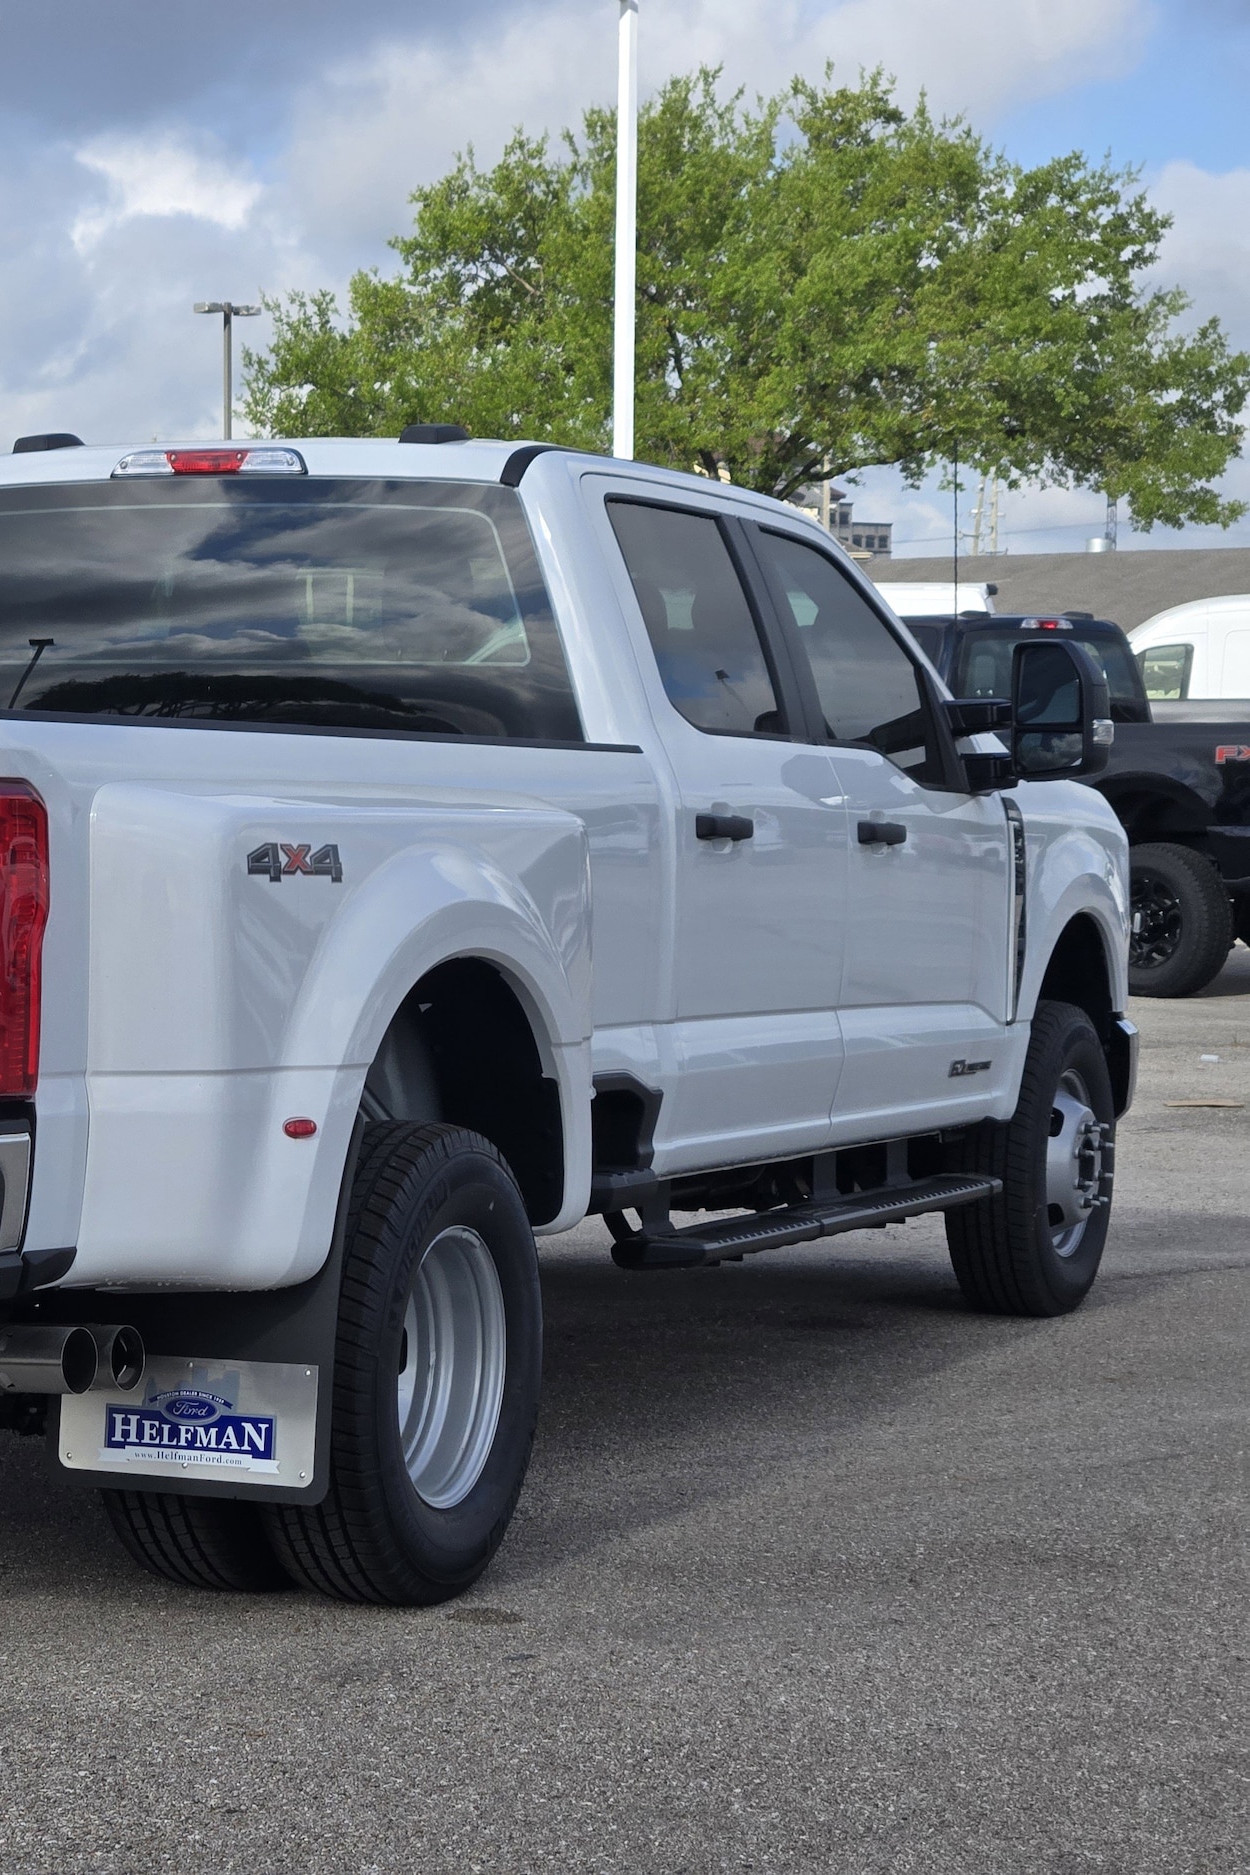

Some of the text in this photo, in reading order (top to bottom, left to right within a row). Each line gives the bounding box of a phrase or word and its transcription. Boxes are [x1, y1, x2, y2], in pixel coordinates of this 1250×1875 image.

[173, 1400, 209, 1416] Ford
[111, 1413, 270, 1452] HELFMAN
[134, 1451, 243, 1466] www.HelfmanFord.com
